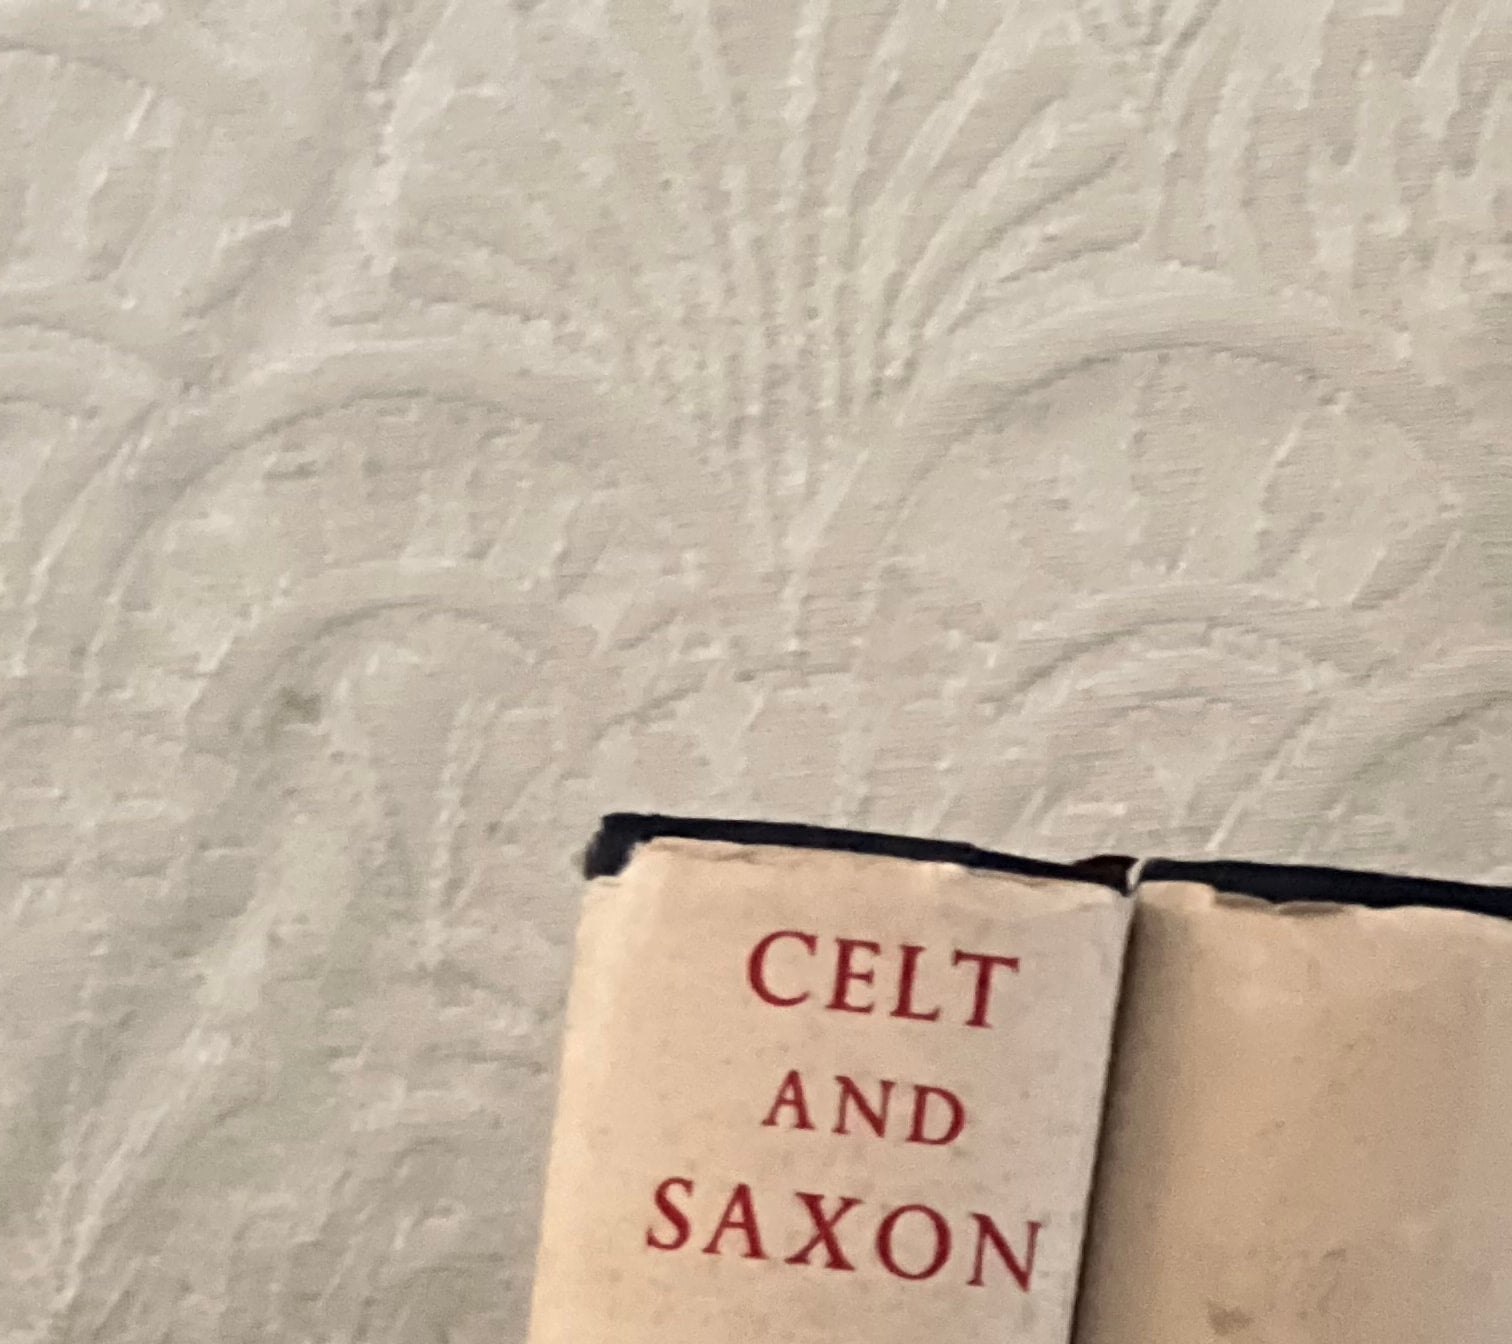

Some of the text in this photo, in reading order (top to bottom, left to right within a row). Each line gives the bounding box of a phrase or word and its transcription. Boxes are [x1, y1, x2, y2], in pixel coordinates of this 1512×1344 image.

[746, 929, 1021, 1030] CELT
[760, 1068, 967, 1147] AND
[644, 1175, 1044, 1293] SAXON
